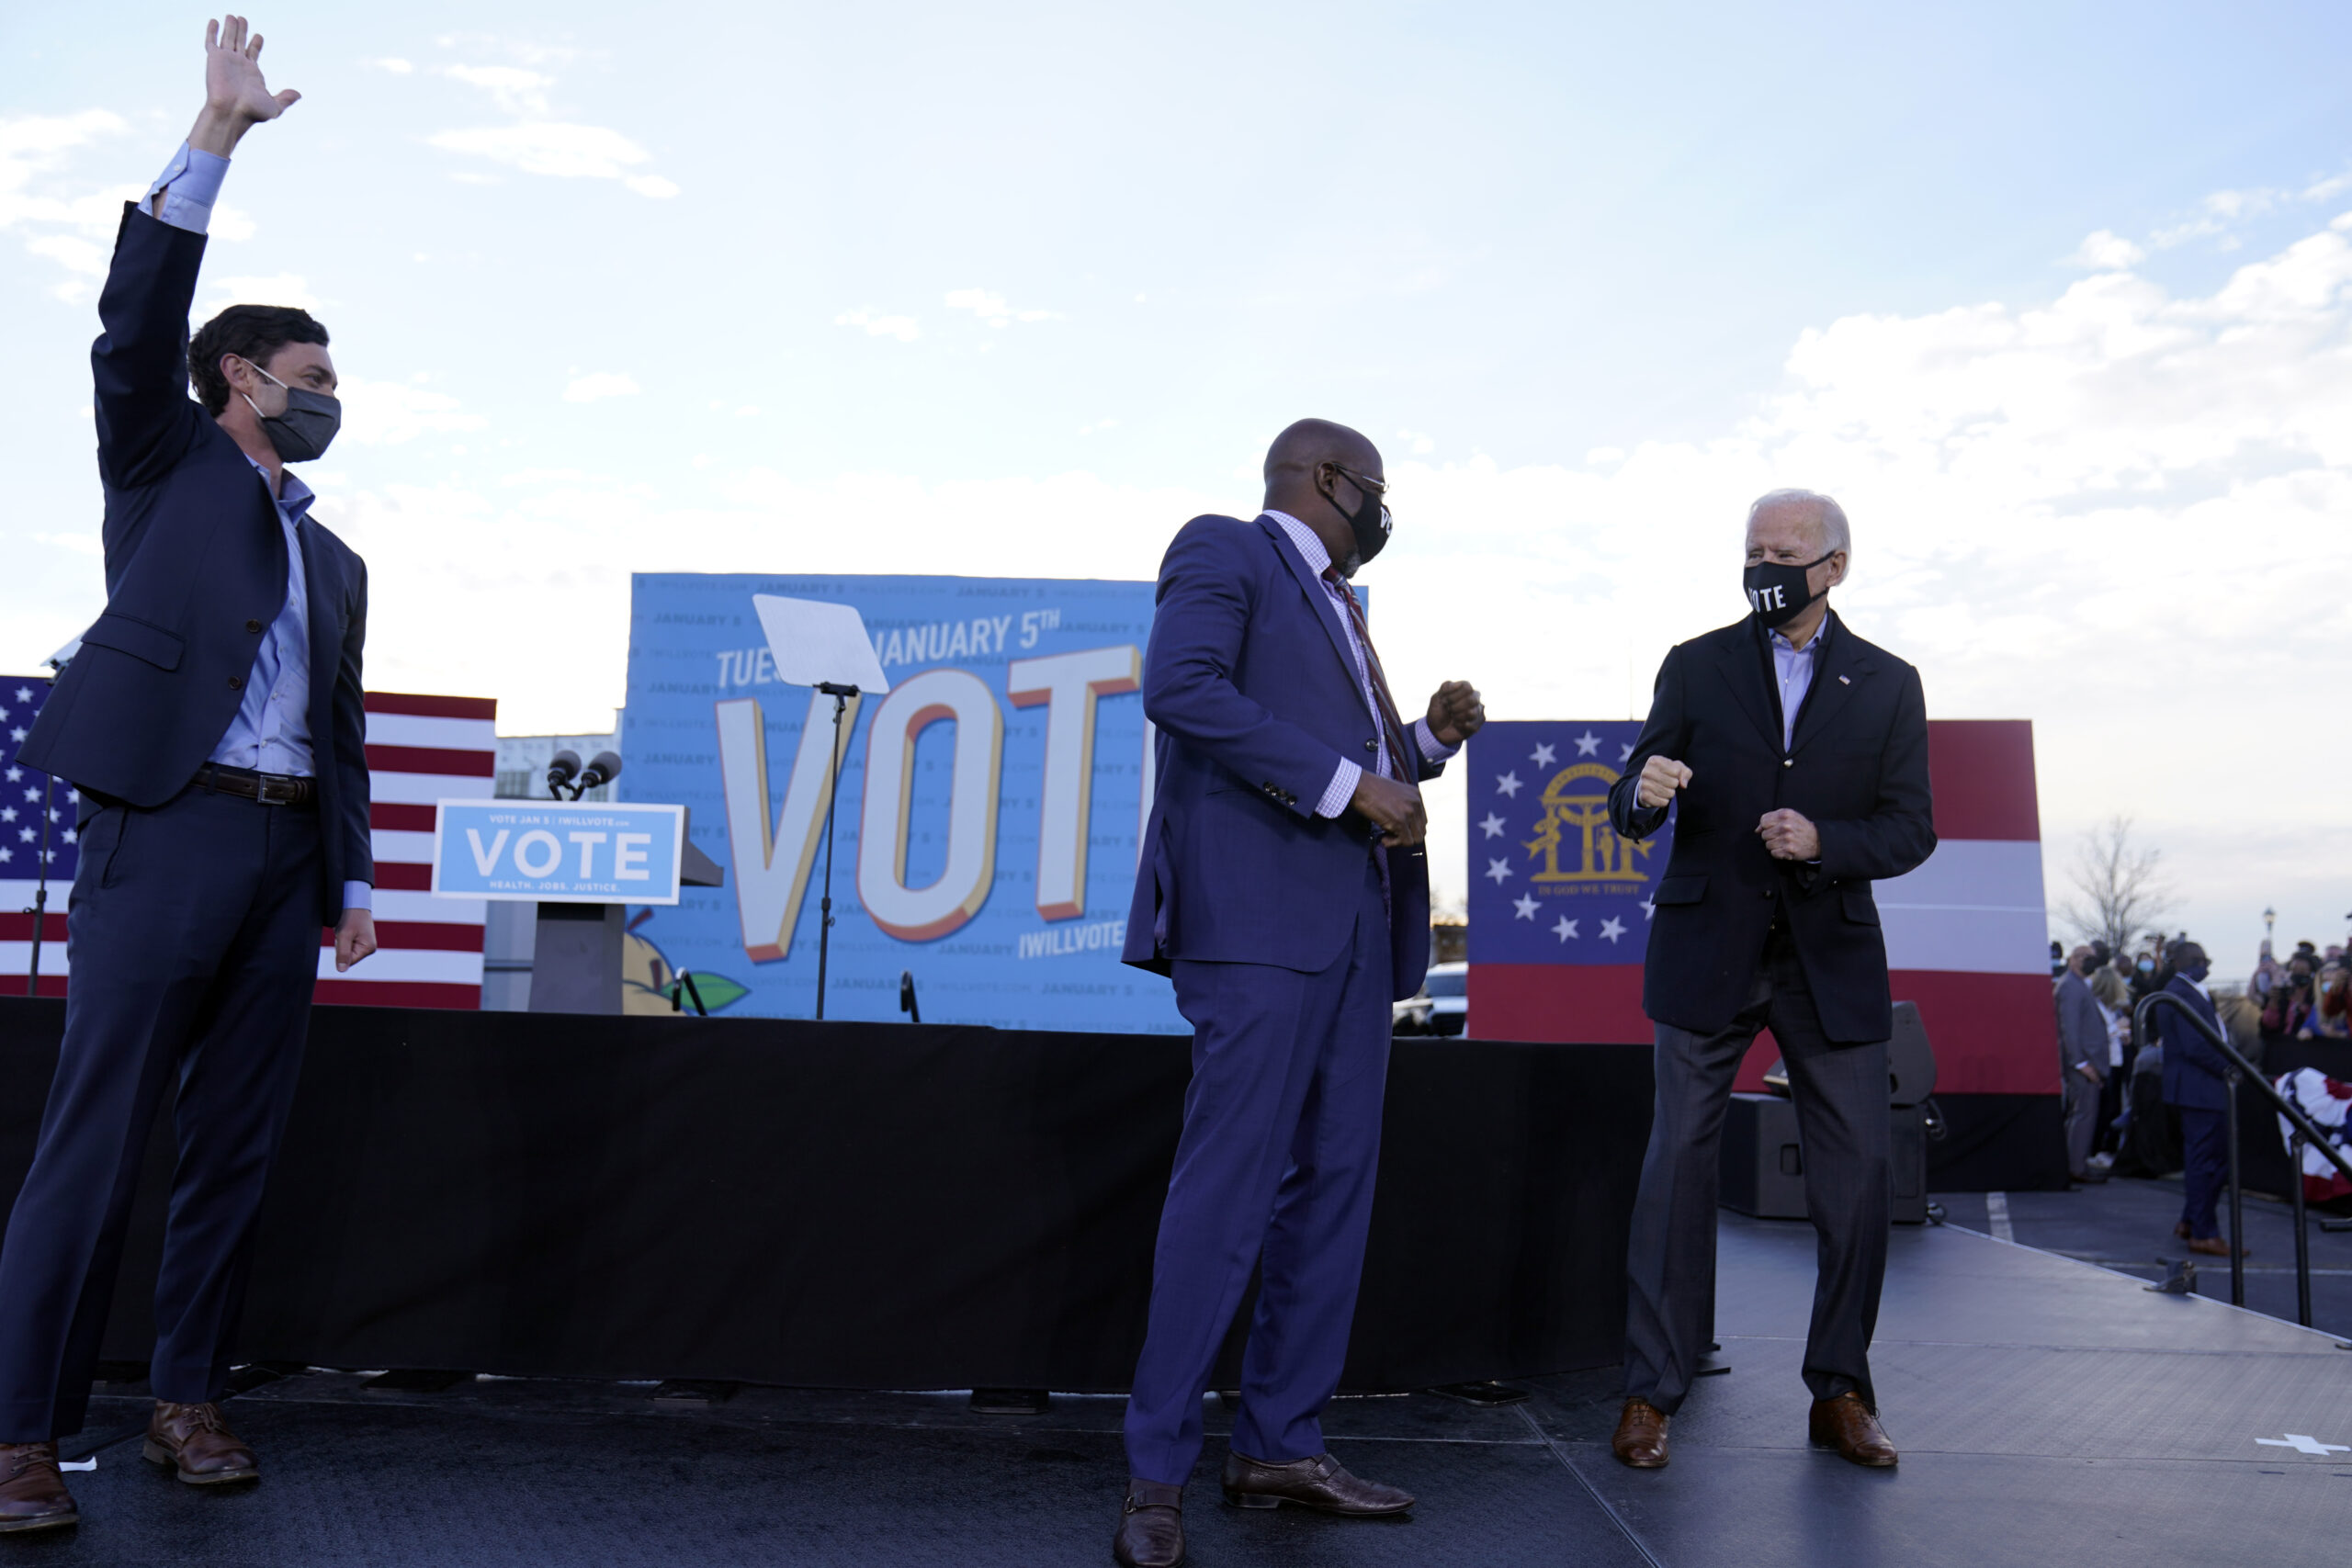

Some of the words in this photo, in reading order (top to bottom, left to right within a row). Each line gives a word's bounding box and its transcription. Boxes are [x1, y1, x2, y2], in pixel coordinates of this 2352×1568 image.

[757, 581, 831, 594] JANUARY
[956, 585, 1030, 598] JANUARY
[1748, 584, 1786, 613] VOTE
[653, 613, 728, 626] JANUARY
[1057, 621, 1131, 634] JANUARY
[717, 643, 781, 689] TUE
[876, 615, 1012, 668] JANUARY
[643, 753, 716, 765] JANUARY
[717, 645, 1148, 964] VOT
[489, 815, 516, 825] VOTE
[520, 815, 539, 825] JAN
[466, 829, 651, 880] VOTE
[490, 881, 535, 891] HEALTH.
[538, 882, 569, 892] JOBS.
[572, 883, 620, 894] JUSTICE.
[937, 942, 1014, 955] JANUARY
[831, 976, 900, 990] JANUAR
[1041, 982, 1120, 996] JANUARY
